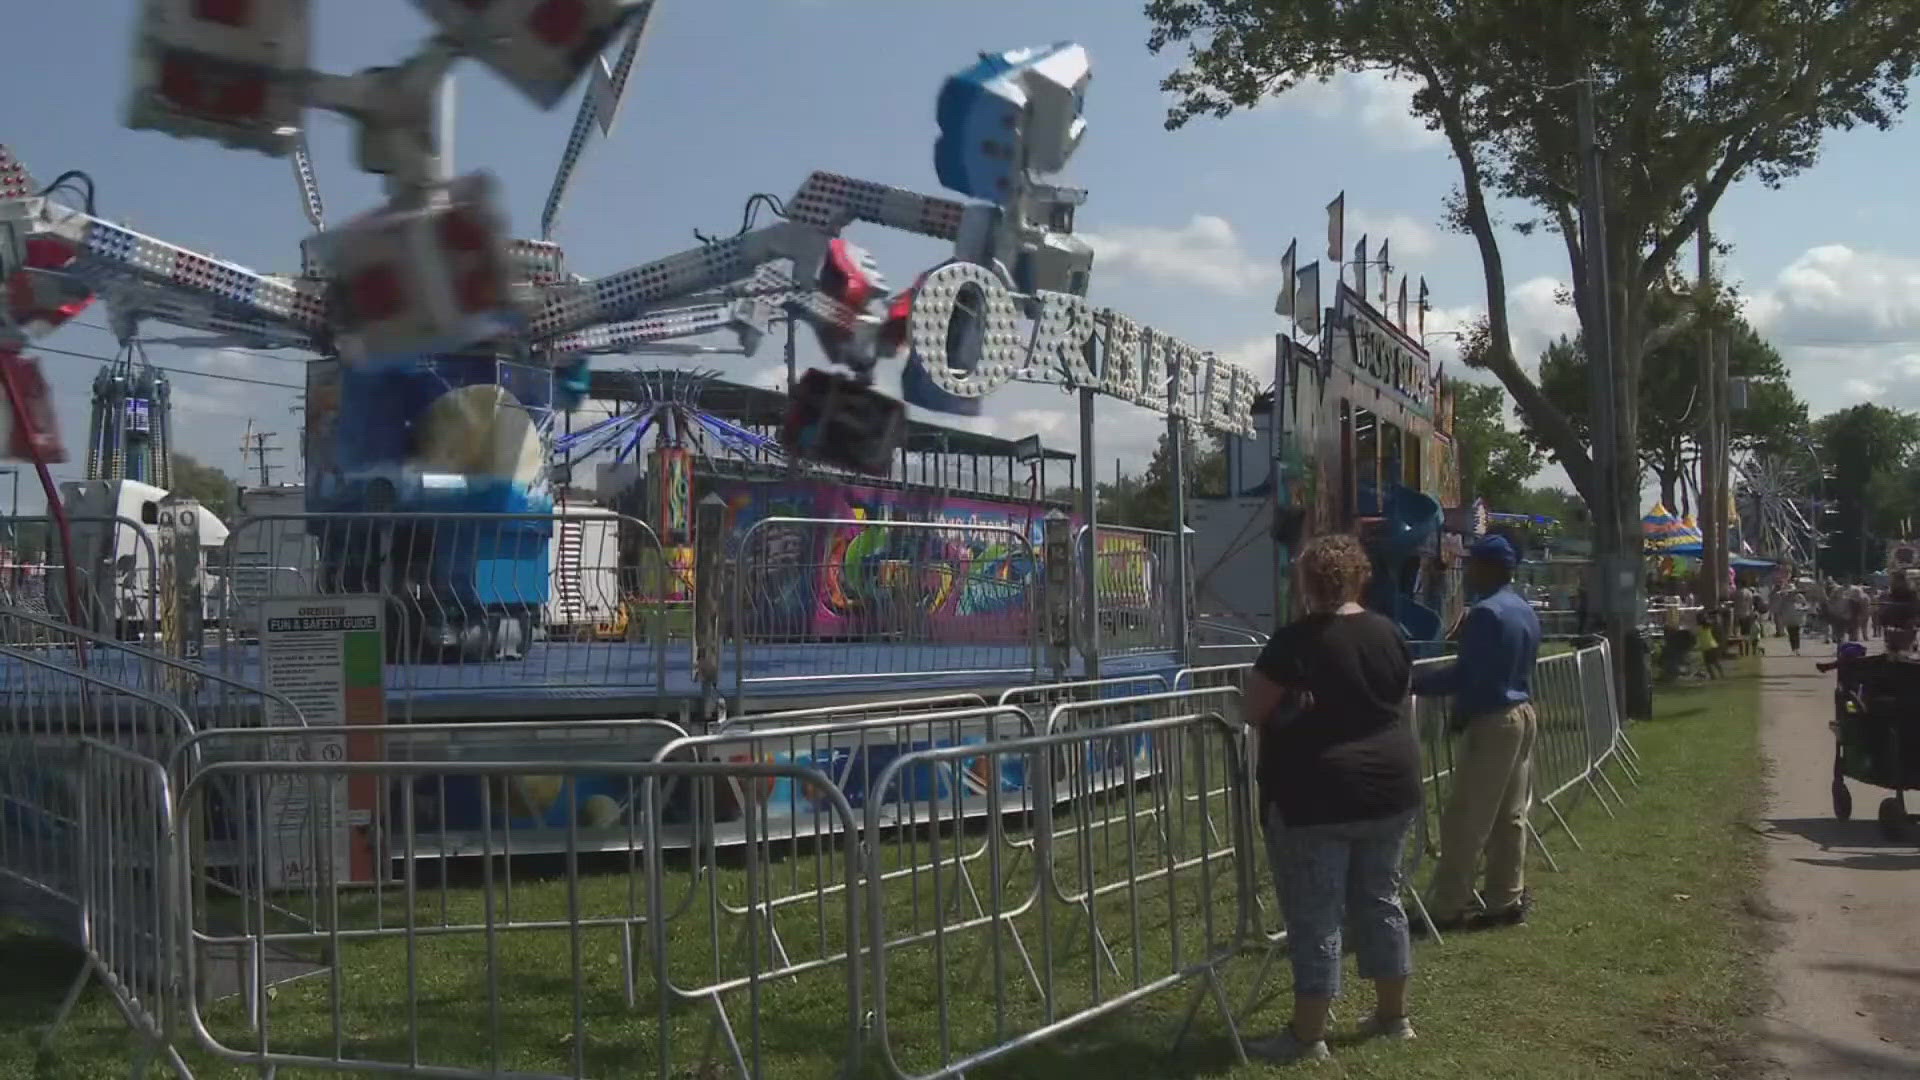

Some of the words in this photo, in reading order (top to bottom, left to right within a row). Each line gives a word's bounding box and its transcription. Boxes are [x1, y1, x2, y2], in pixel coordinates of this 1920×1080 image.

[911, 261, 1257, 439] ORBITER
[271, 619, 291, 630] FUN
[303, 617, 341, 629] SAFETY
[343, 616, 375, 628] GUIDE
